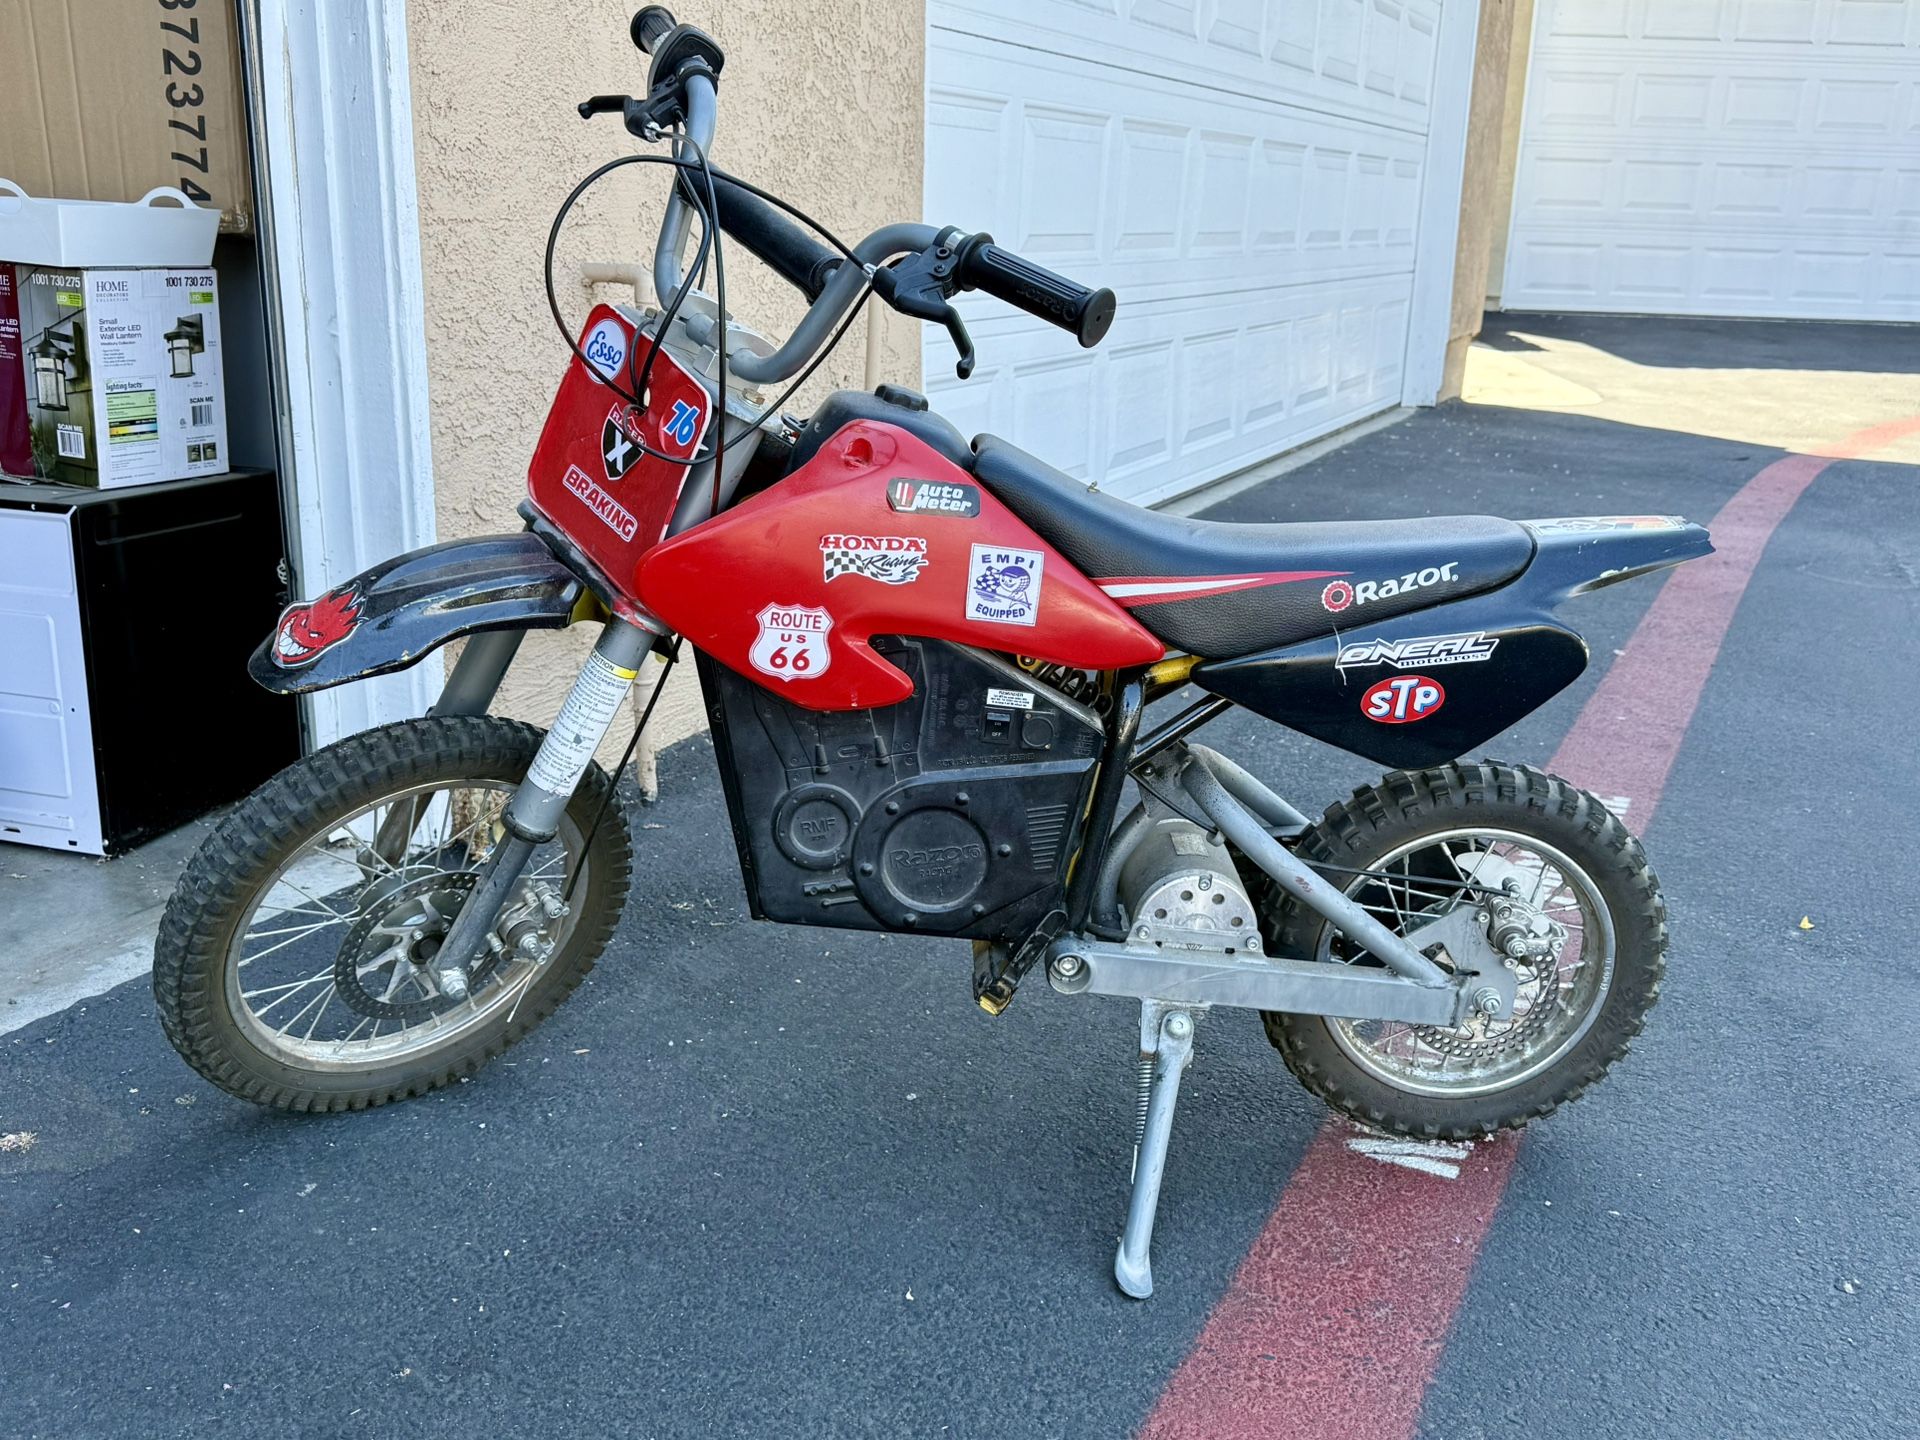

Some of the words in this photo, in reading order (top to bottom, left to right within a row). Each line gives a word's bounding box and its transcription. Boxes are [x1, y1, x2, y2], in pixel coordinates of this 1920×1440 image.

[31, 273, 48, 285] 1001
[50, 274, 65, 287] 730
[66, 276, 80, 288] 275
[96, 281, 128, 292] HOME
[165, 277, 182, 287] 1001
[185, 276, 198, 287] 730
[199, 276, 213, 287] 275
[664, 399, 700, 446] 76
[916, 483, 964, 499] Auto
[566, 469, 635, 537] BRAKING
[914, 495, 972, 512] Meter
[821, 537, 925, 552] HONDA
[862, 554, 927, 573] Racing
[981, 554, 1035, 569] EMPI
[975, 603, 1026, 619] EQUIPPED
[770, 611, 822, 629] ROUTE
[769, 647, 811, 671] 66
[1400, 653, 1488, 666] motocross
[1367, 678, 1440, 719] STP
[800, 817, 836, 833] RMF
